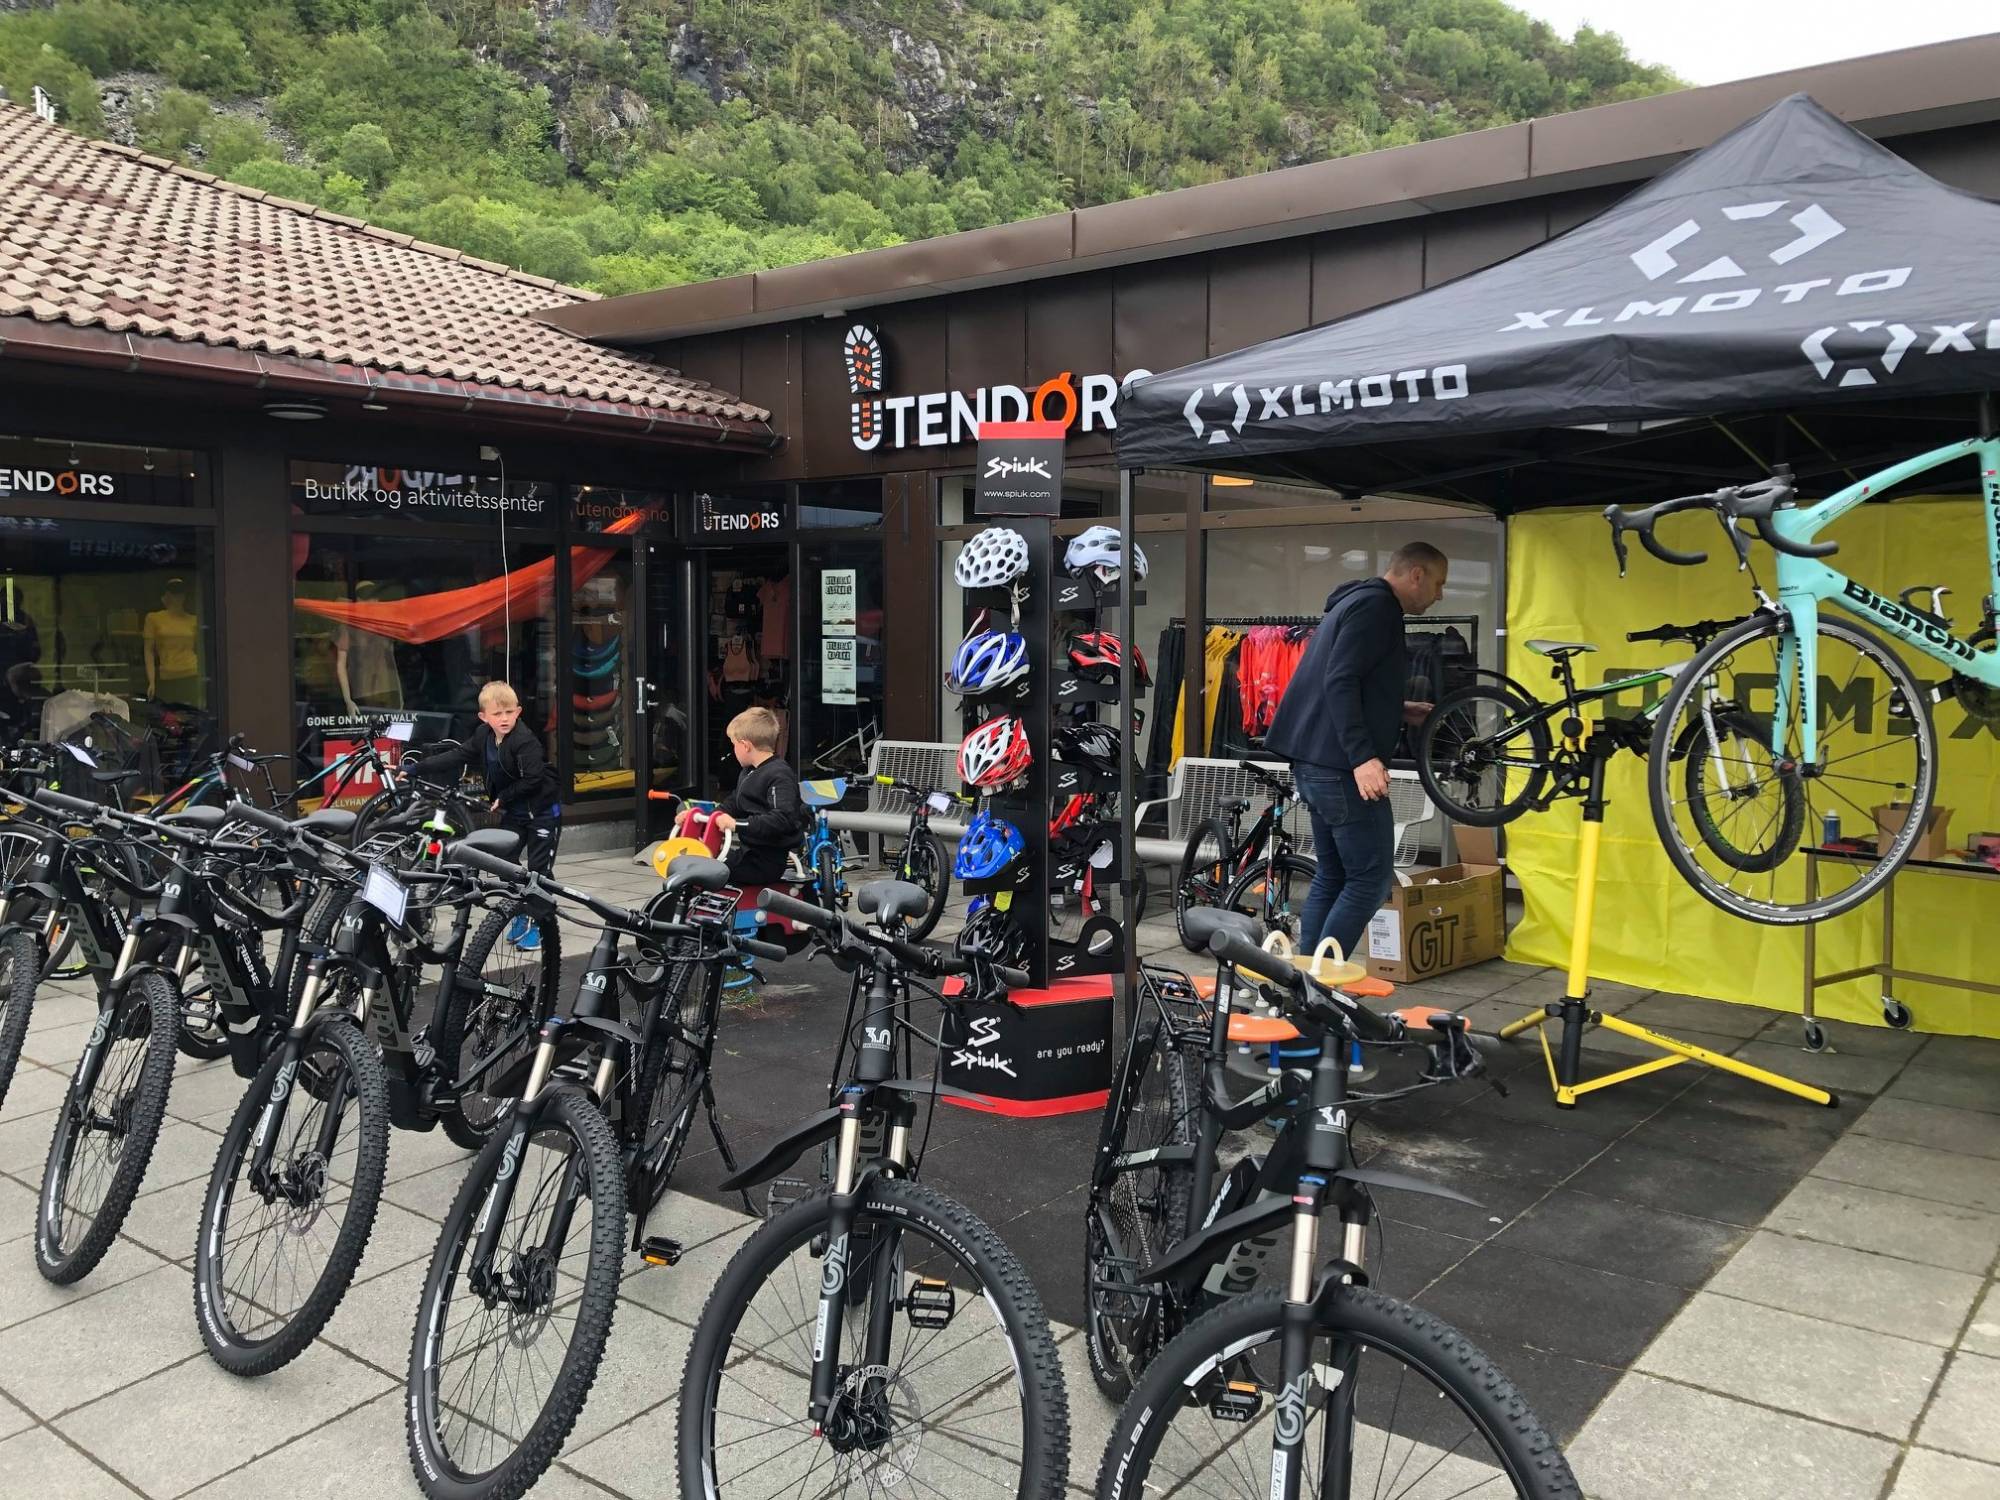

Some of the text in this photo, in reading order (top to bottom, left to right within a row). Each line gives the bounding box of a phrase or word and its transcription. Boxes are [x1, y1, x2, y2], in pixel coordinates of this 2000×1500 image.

[1496, 267, 1913, 332] XLMOTO
[851, 368, 1153, 451] UTENDØR
[1259, 364, 1469, 421] XLMOTO
[983, 456, 1052, 479] Spiuk
[305, 478, 545, 512] Butikk og aktivitetssenter
[983, 489, 1051, 499] www.spiuk.com
[1843, 578, 1976, 661] Bianchi
[306, 713, 418, 727] GONE ON MY ATWALK
[1408, 914, 1460, 975] GT
[950, 1048, 1018, 1078] Spiuk
[1037, 1040, 1105, 1060] are you ready?
[1109, 1405, 1153, 1500] WALBE
